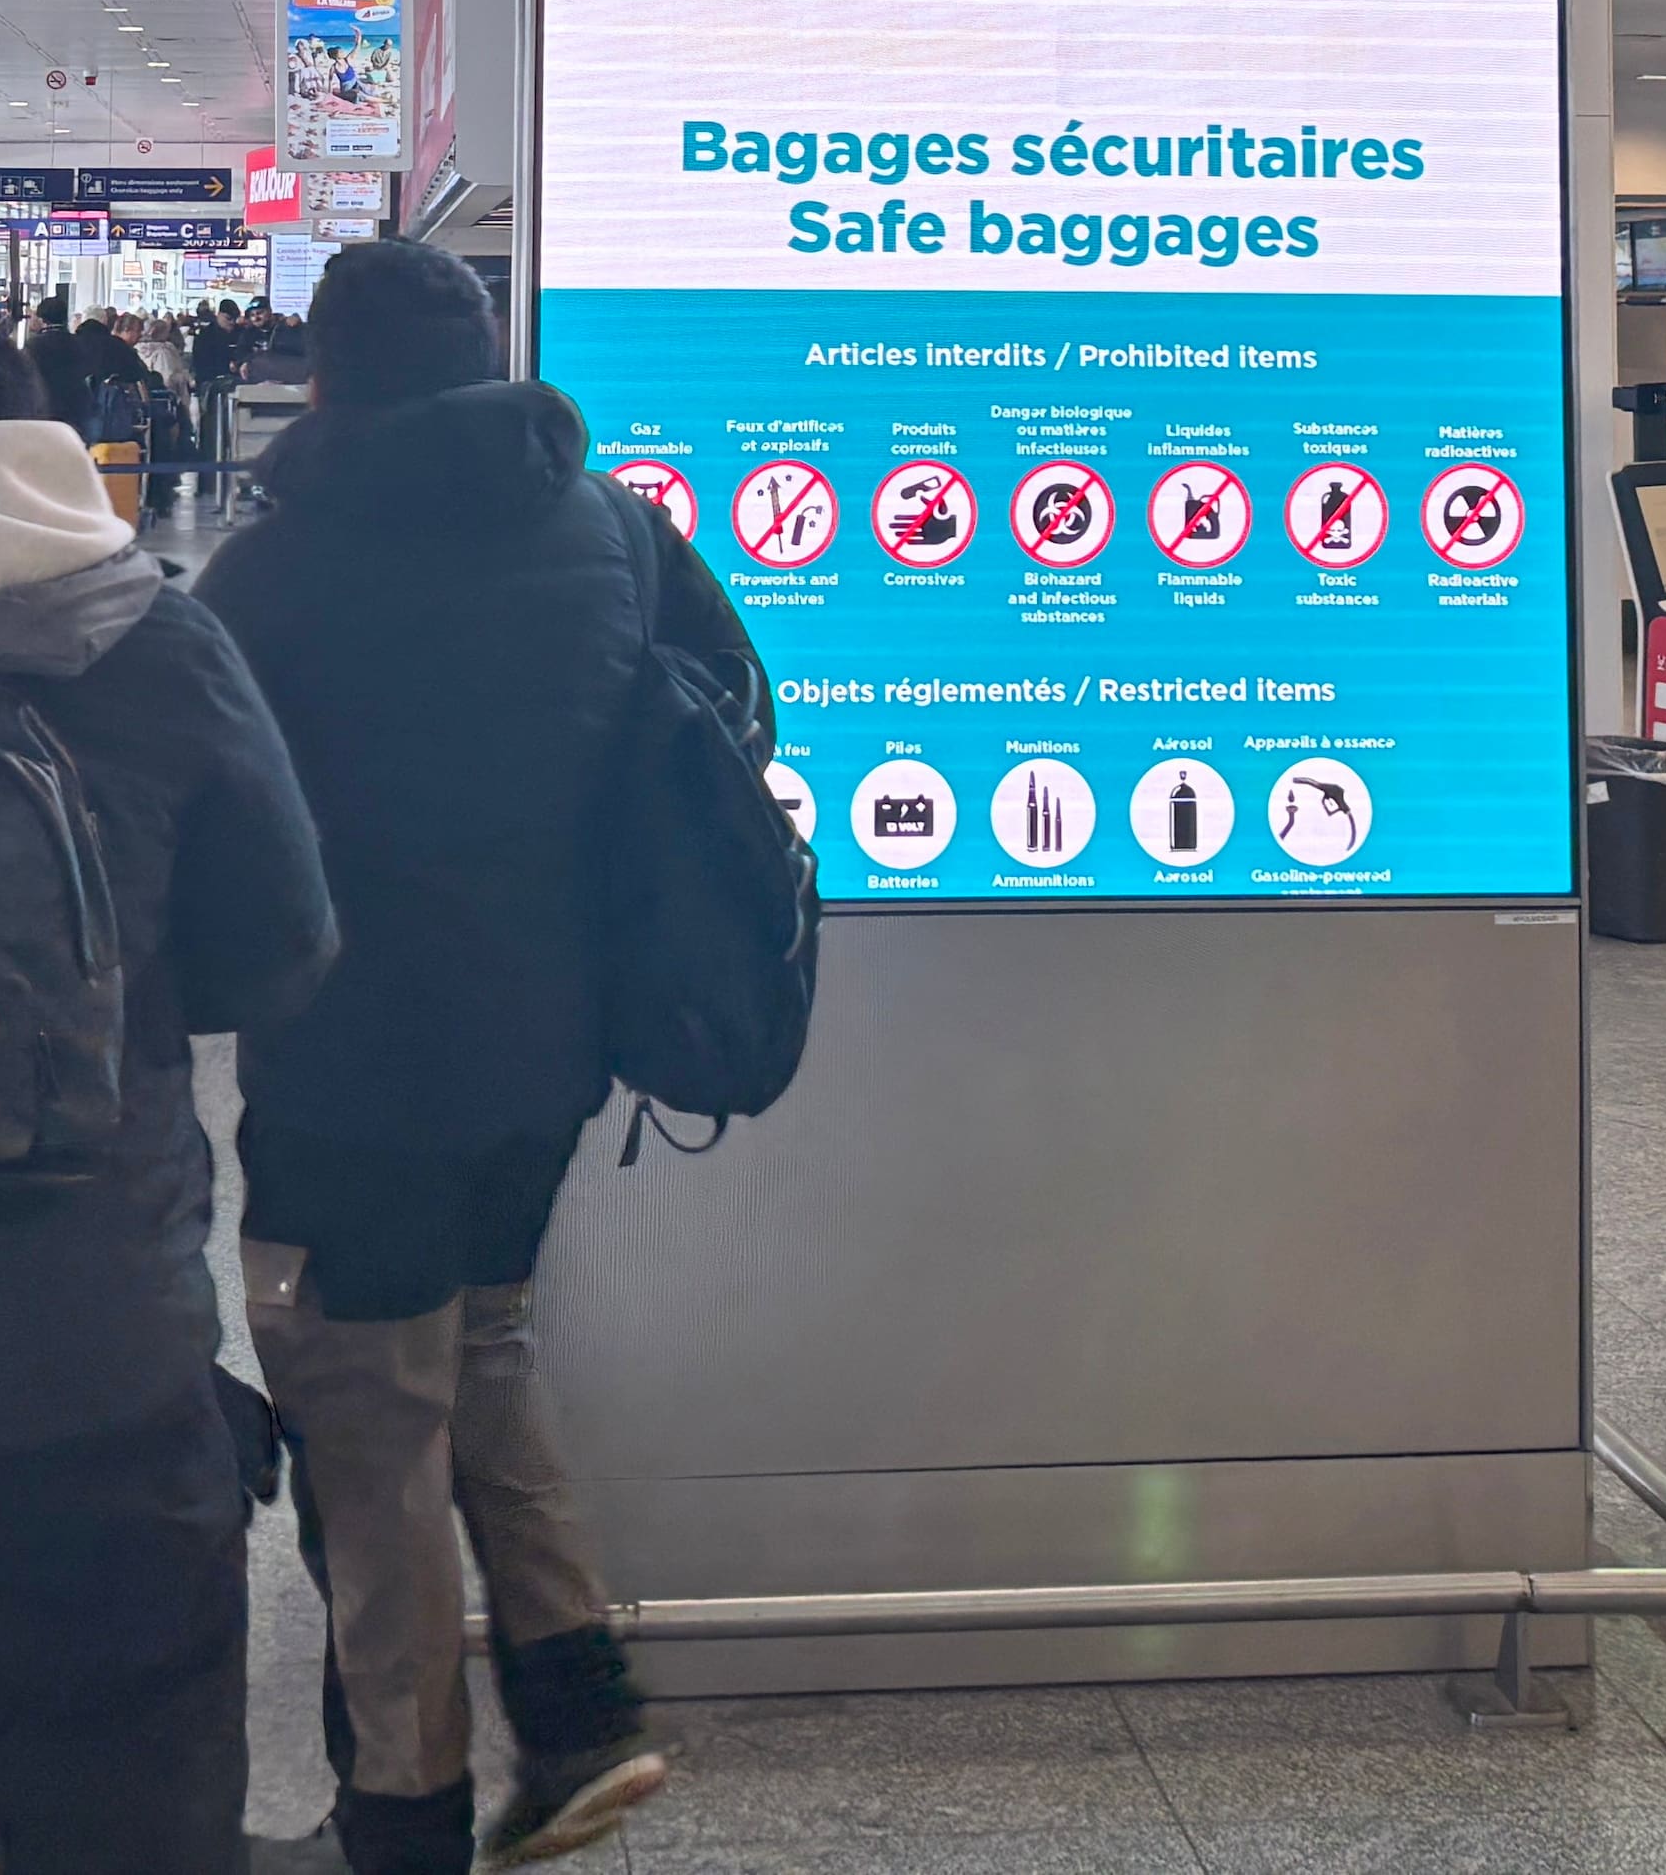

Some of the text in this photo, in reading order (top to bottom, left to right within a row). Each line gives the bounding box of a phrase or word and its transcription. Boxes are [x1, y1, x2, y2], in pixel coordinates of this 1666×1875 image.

[683, 120, 1424, 185] Bagages sécuritaires
[34, 222, 49, 236] A
[181, 224, 194, 238] C
[788, 201, 1320, 266] Safe baggages
[805, 344, 1317, 371] Articles interdits / Prohibited items
[991, 406, 1132, 420] Danger biologique
[630, 423, 661, 435] Gaz
[726, 420, 844, 433] Feux d'artifices
[892, 423, 956, 436] Produits
[1017, 423, 1107, 437] ou matières
[1166, 425, 1231, 439] Liquides
[1293, 423, 1378, 436] Substances
[1439, 426, 1503, 439] Matières
[597, 442, 693, 455] inflammable
[741, 439, 829, 453] et explosifs
[891, 442, 957, 455] corrosifs
[1016, 442, 1107, 456] infectieuses
[1148, 443, 1249, 456] inflammables
[1303, 442, 1367, 456] toxiques
[1425, 445, 1517, 458] radioactives
[730, 573, 838, 586] Fireworks and
[884, 573, 964, 586] Corrosives
[1024, 573, 1101, 586] Biohazard
[1158, 573, 1242, 587] Flammable
[1318, 573, 1356, 587] Toxic
[1428, 574, 1518, 587] Radioactive
[744, 592, 824, 607] explosives
[1008, 592, 1117, 606] and infectious
[1174, 592, 1225, 606] liquids
[1296, 593, 1379, 606] substances
[1439, 593, 1508, 606] materials
[1021, 610, 1104, 624] substances
[777, 676, 1335, 706] Objets réglementés / Restricted items
[786, 743, 810, 757] feu
[886, 741, 922, 755] Piles
[1006, 739, 1080, 755] Munitions
[1153, 736, 1213, 751] Aérosol
[1244, 735, 1396, 752] Appareils à essence
[868, 874, 939, 890] Batteries
[992, 873, 1095, 888] Ammunitions
[1154, 869, 1214, 884] Aerosol
[1251, 868, 1391, 885] Gasoline-powered
